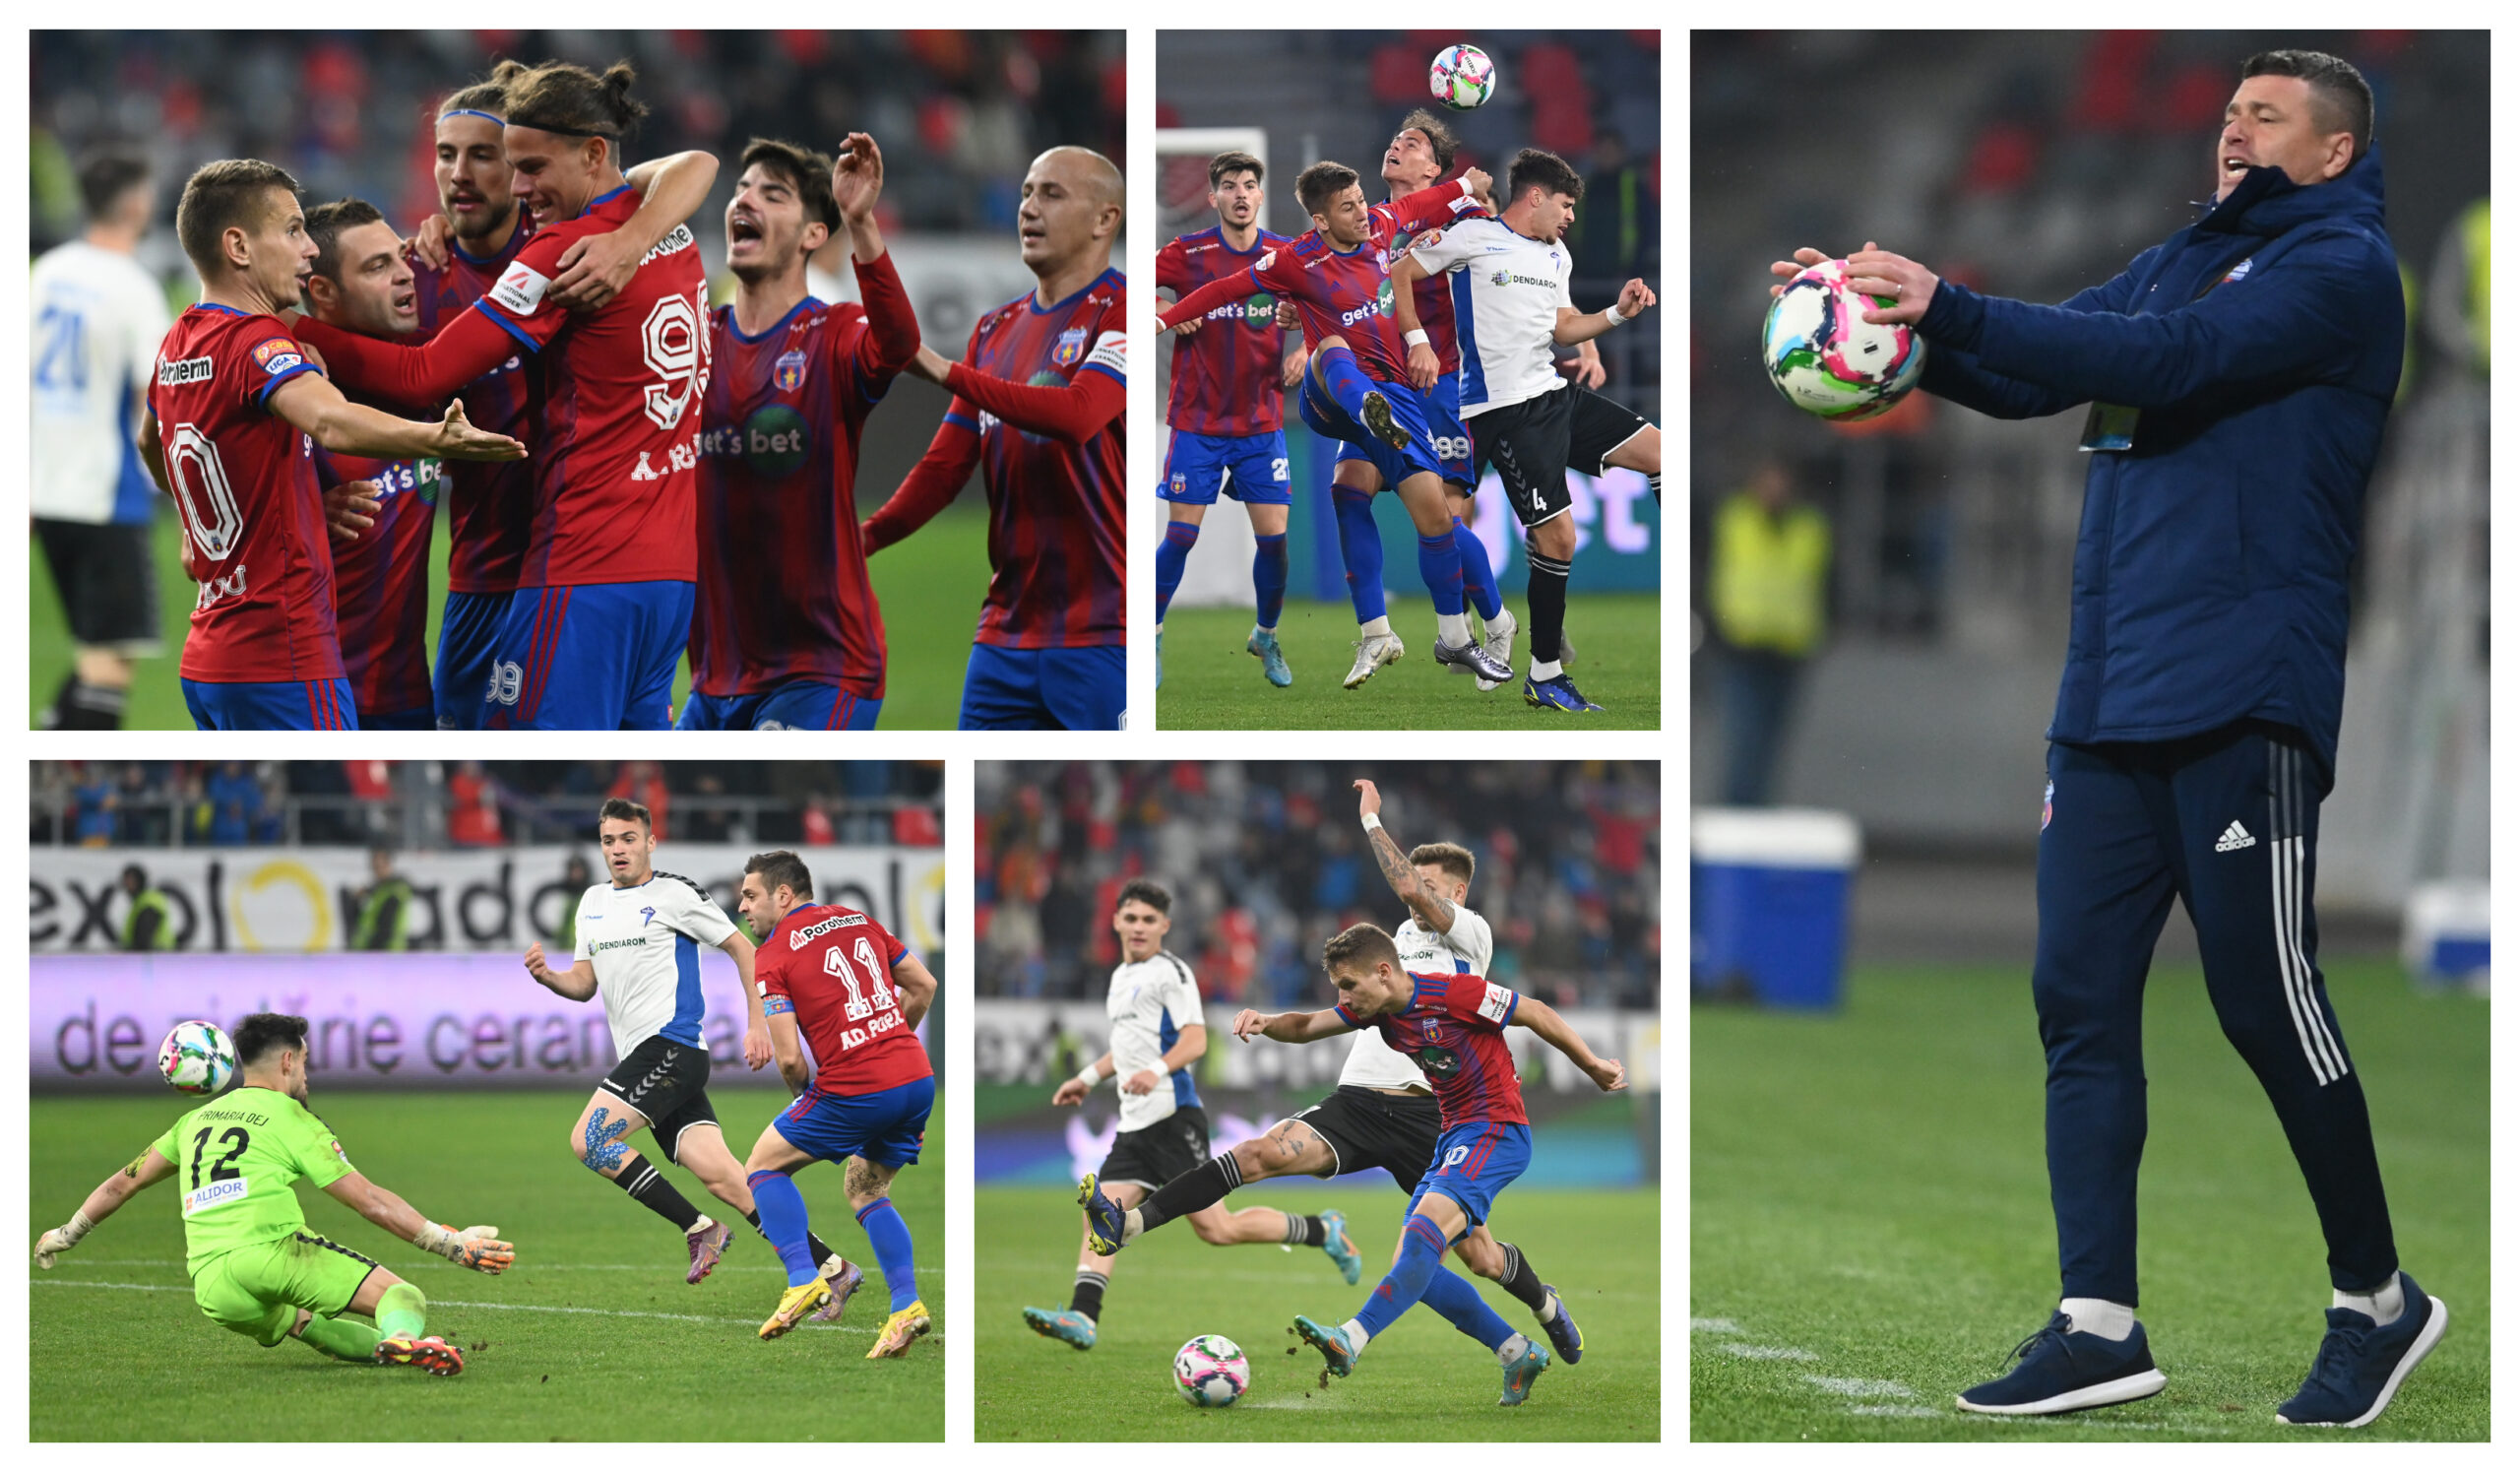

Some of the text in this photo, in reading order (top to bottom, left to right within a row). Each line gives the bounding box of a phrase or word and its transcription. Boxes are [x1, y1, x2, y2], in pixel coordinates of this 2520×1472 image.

[1248, 303, 1273, 317] bet
[1342, 299, 1378, 326] get's
[270, 356, 290, 371] LIGA
[750, 428, 802, 454] bet
[1434, 436, 1470, 460] 99
[371, 459, 442, 498] et's be
[1533, 488, 1546, 511] 4
[2215, 836, 2256, 853] adidas
[803, 914, 867, 938] Porotherm
[598, 937, 647, 950] DENDIAROM
[824, 937, 897, 1022] 11
[57, 994, 145, 1075] de
[245, 1113, 271, 1126] DEJ
[191, 1126, 250, 1190] 12
[196, 1182, 243, 1203] ALIDOR
